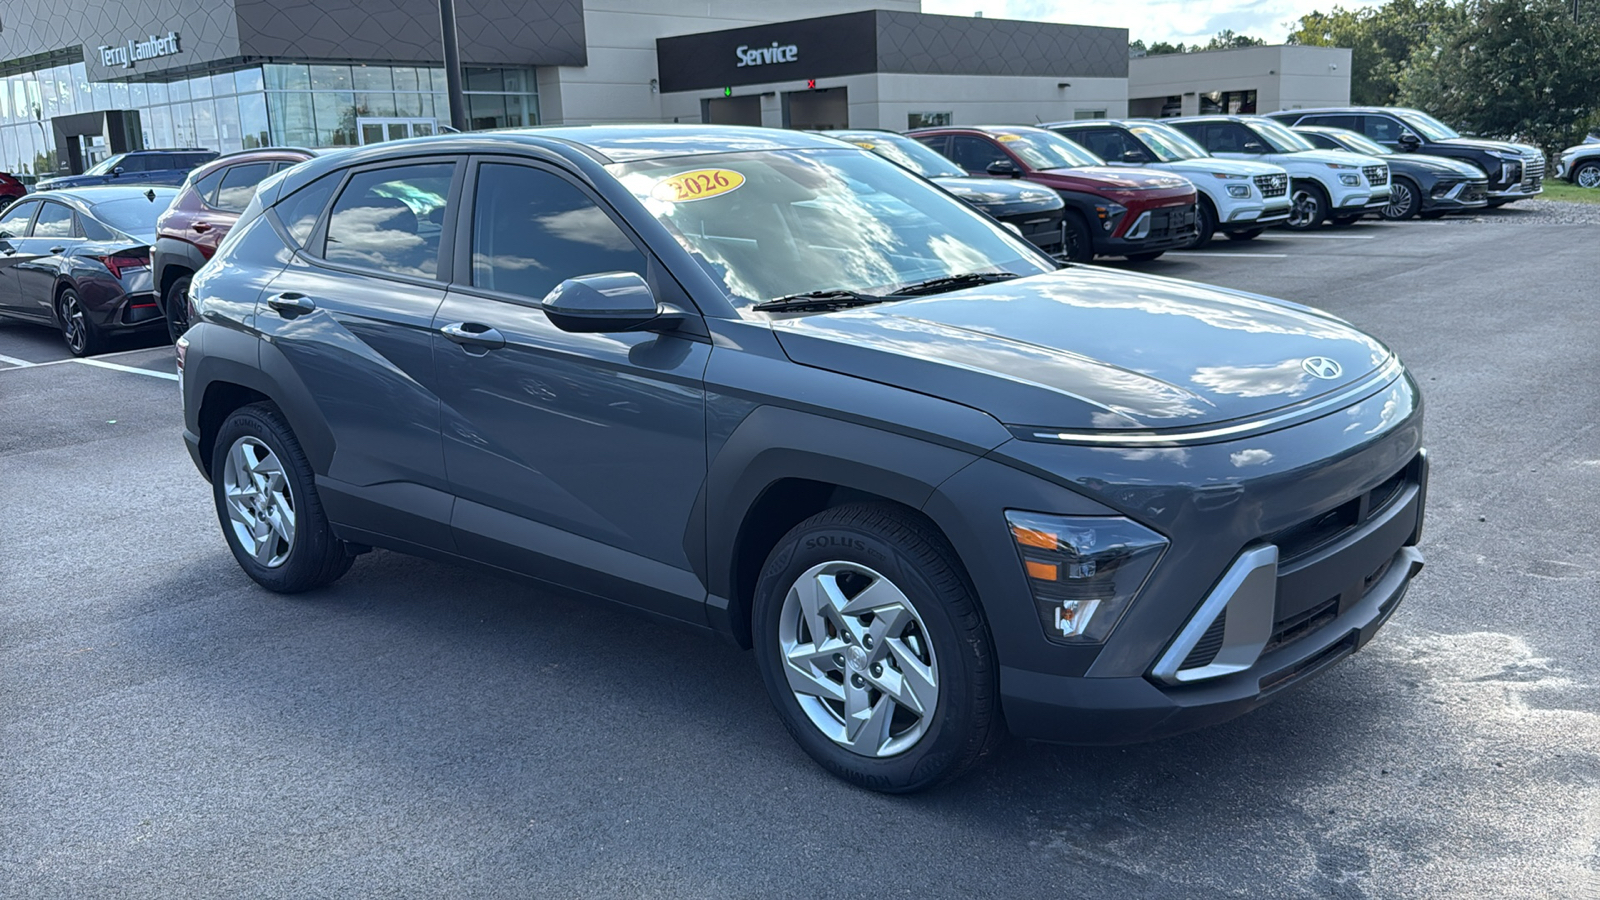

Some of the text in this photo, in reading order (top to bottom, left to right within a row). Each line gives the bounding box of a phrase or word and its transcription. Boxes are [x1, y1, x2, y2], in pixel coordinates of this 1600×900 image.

[98, 31, 179, 68] Terry Lambert
[736, 42, 798, 67] Service
[667, 170, 729, 199] 2026
[234, 419, 263, 433] KUMHO
[806, 535, 866, 551] SOLUS
